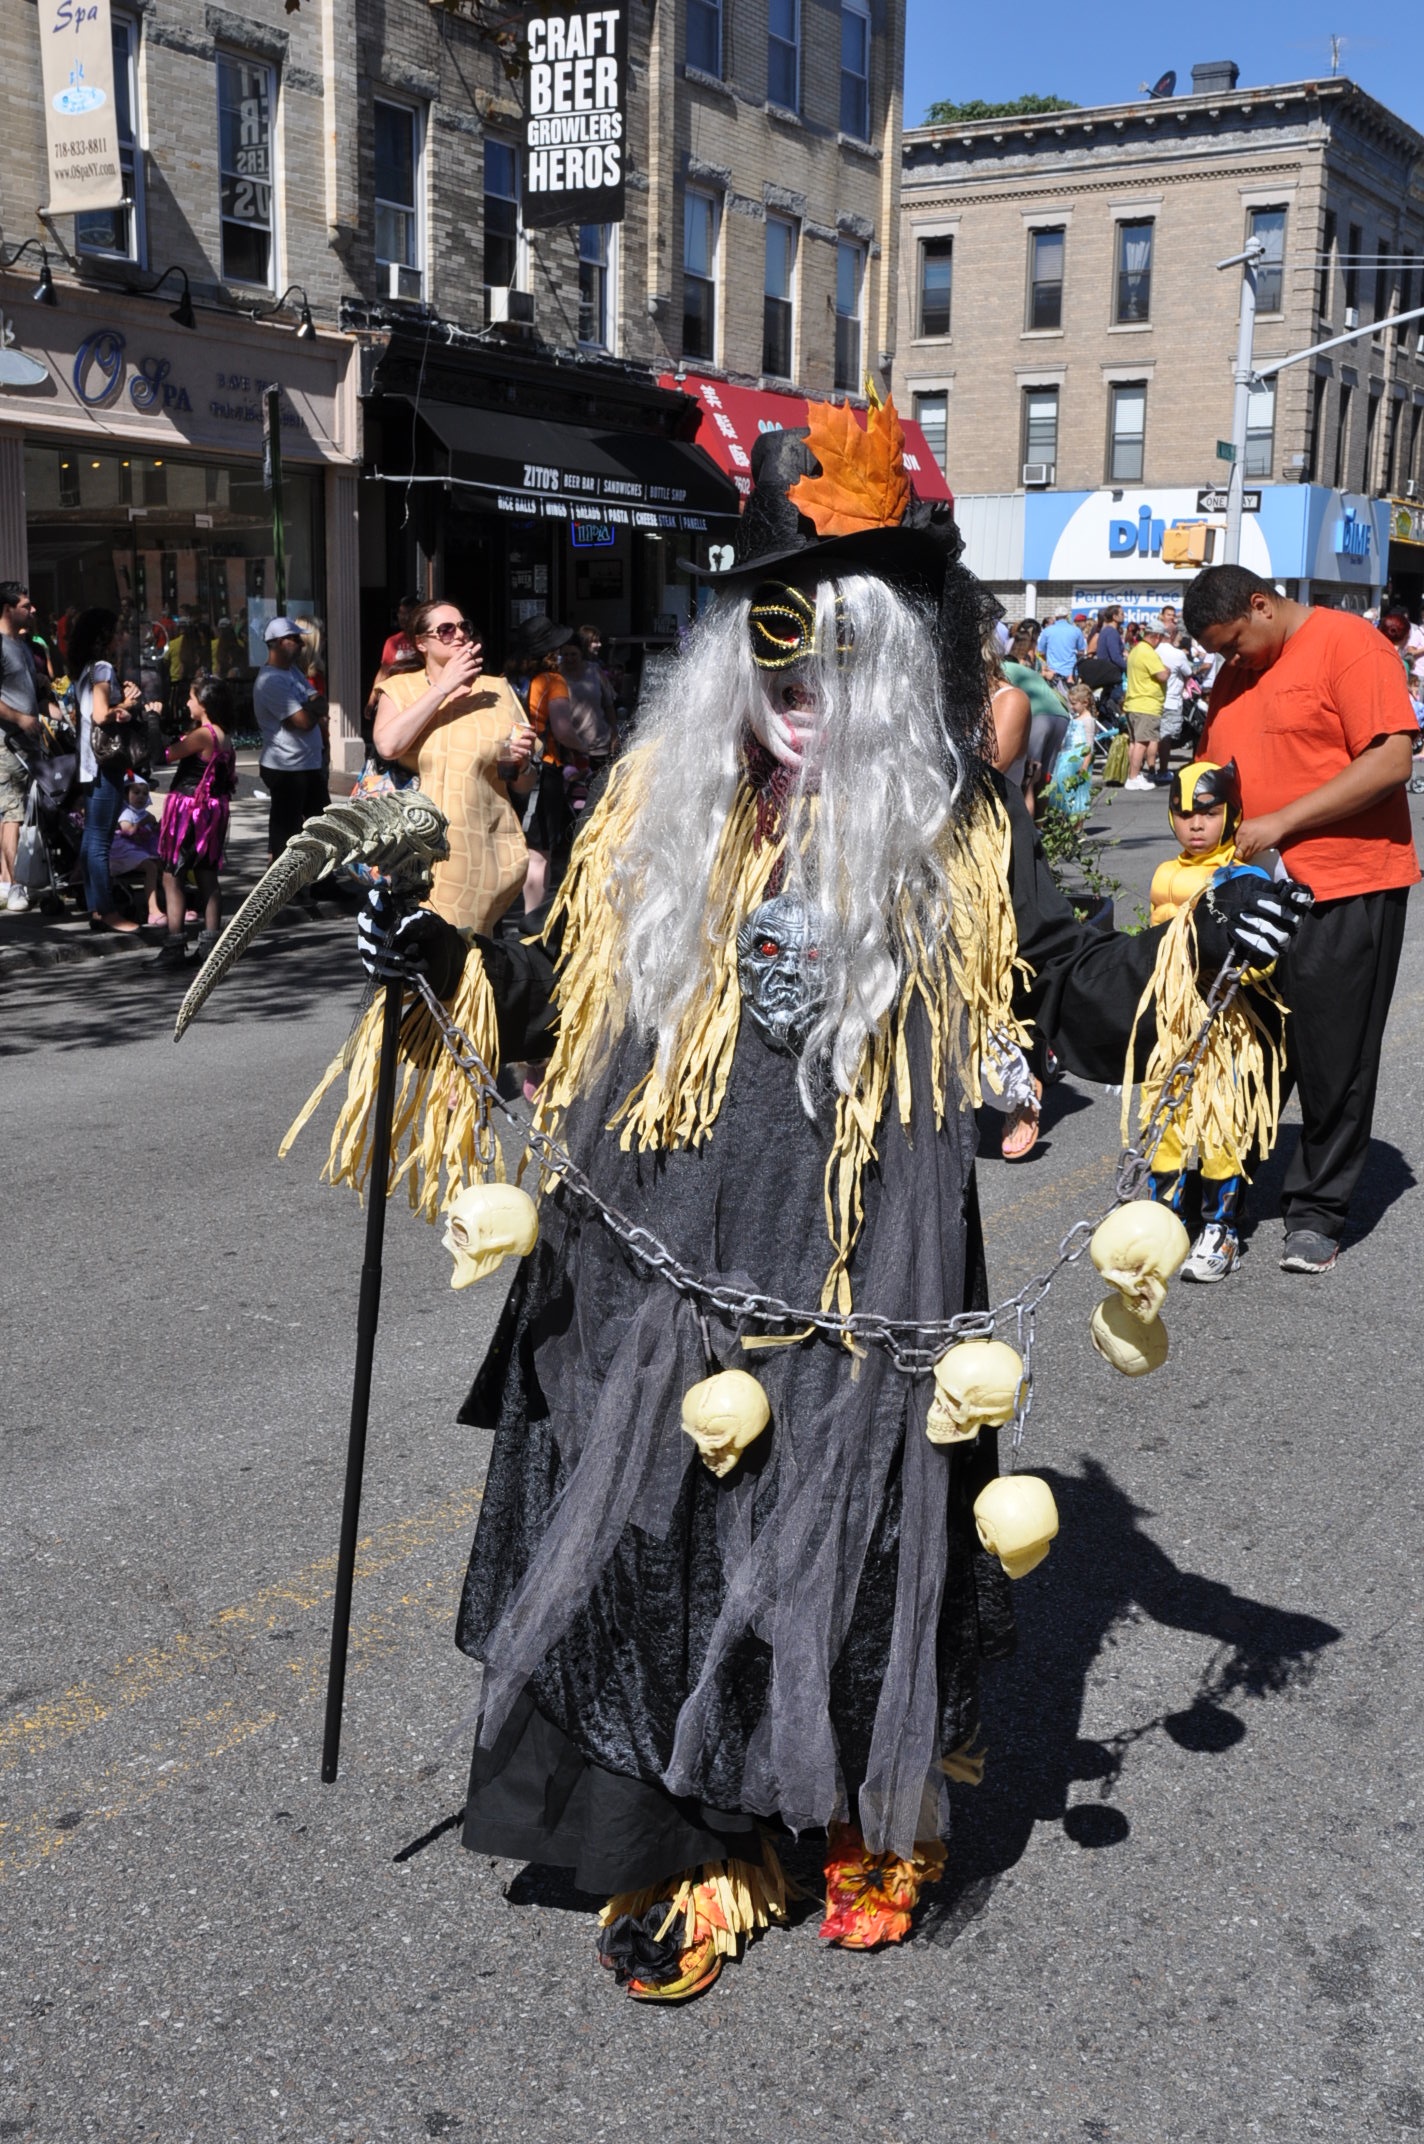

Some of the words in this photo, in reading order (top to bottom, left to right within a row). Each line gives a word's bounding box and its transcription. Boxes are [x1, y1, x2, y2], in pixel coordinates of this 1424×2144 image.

[53, 0, 97, 33] Spa
[528, 10, 620, 63] CRAFT
[530, 57, 618, 115] BEER
[528, 112, 622, 146] GROWLERS
[55, 138, 107, 158] 718-833-8811
[528, 144, 621, 192] HEROS
[73, 330, 126, 404] O
[523, 464, 560, 491] ZITO'S
[563, 474, 581, 489] BEER
[582, 476, 595, 491] BAR
[603, 479, 643, 497] SANDWICHES
[649, 485, 671, 500] BOTTLE
[671, 488, 687, 502] SHOP
[497, 495, 514, 511] RICE
[515, 498, 537, 514] BALLS
[545, 501, 567, 517] WINGS
[575, 504, 601, 521] SALADS
[608, 508, 629, 524] PASTA
[635, 511, 659, 527] CHEESE
[658, 513, 677, 528] STEAK
[1206, 497, 1225, 507] ONE
[1075, 589, 1140, 604] Perfectly
[1147, 589, 1180, 603] Free
